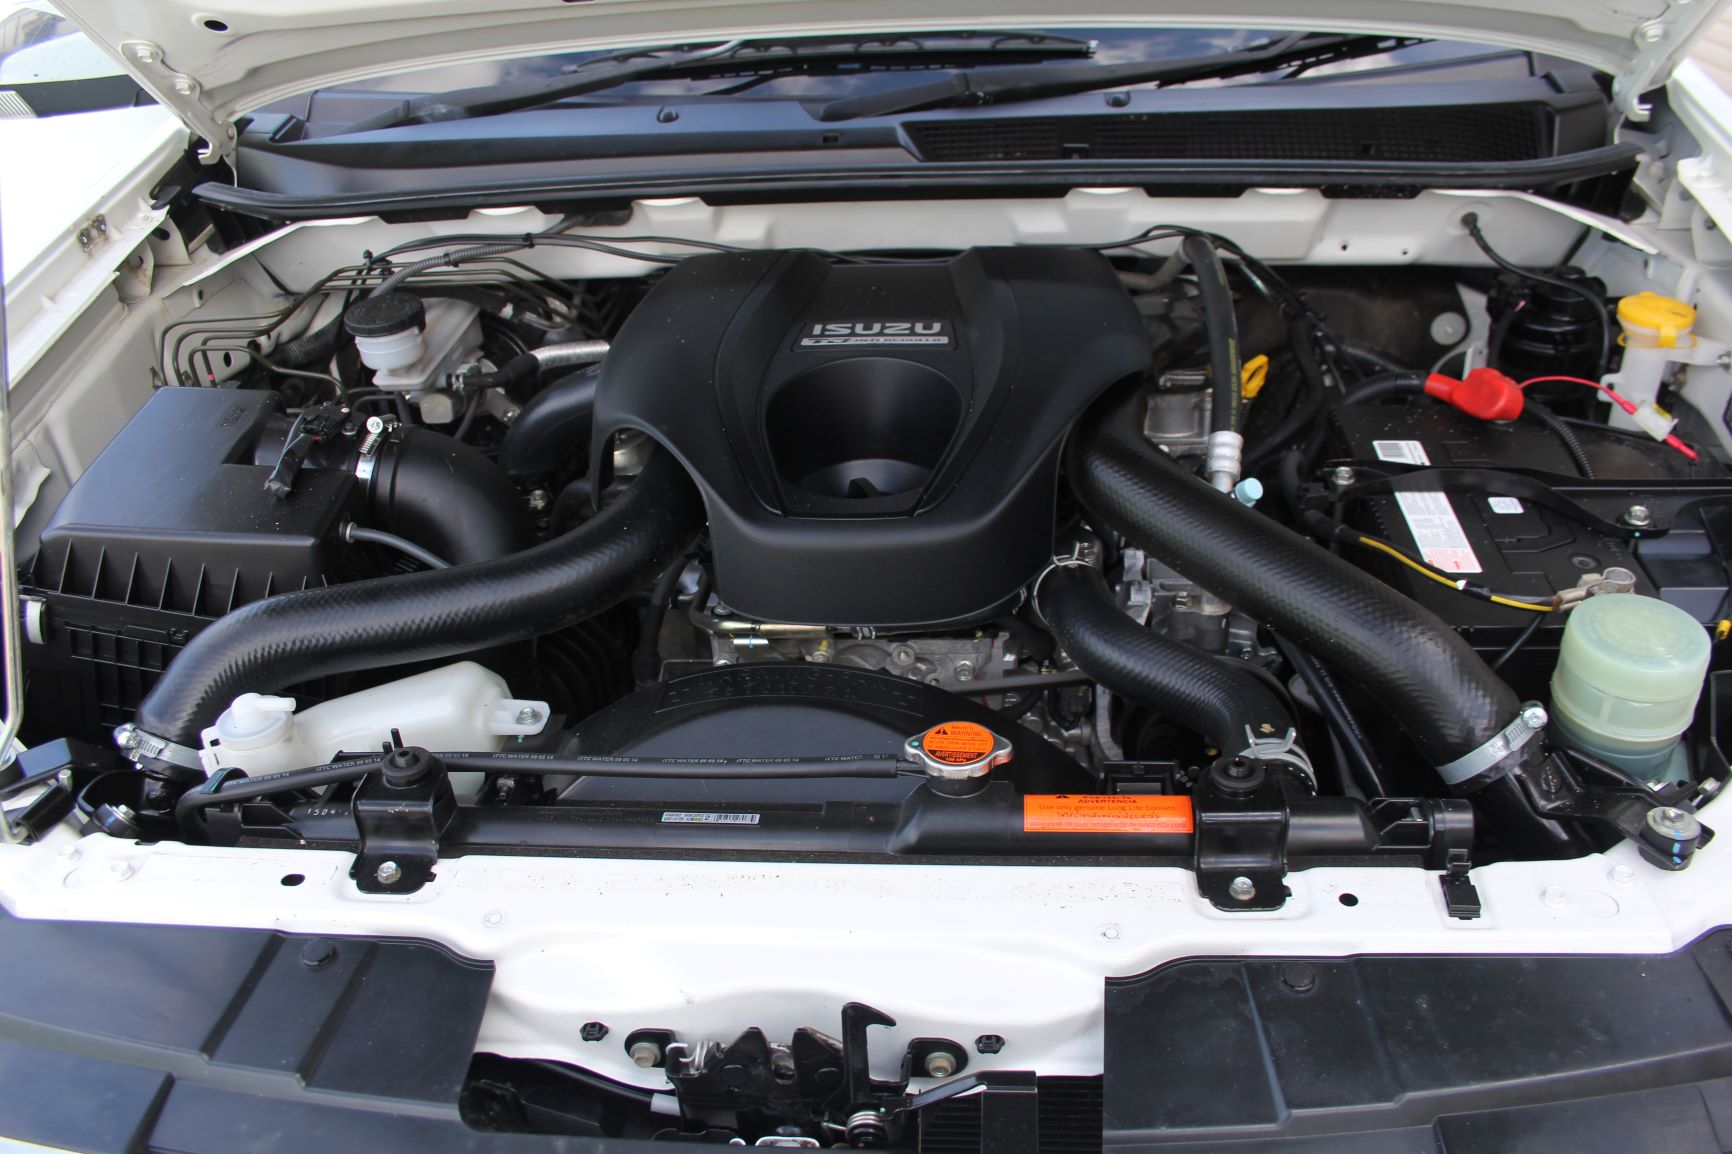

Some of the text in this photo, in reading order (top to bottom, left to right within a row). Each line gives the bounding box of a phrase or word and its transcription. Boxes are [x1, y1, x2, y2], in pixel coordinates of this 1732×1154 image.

[812, 322, 942, 335] ISUZU
[935, 751, 978, 759] AVERTISSEMENT
[332, 760, 356, 769] WATER
